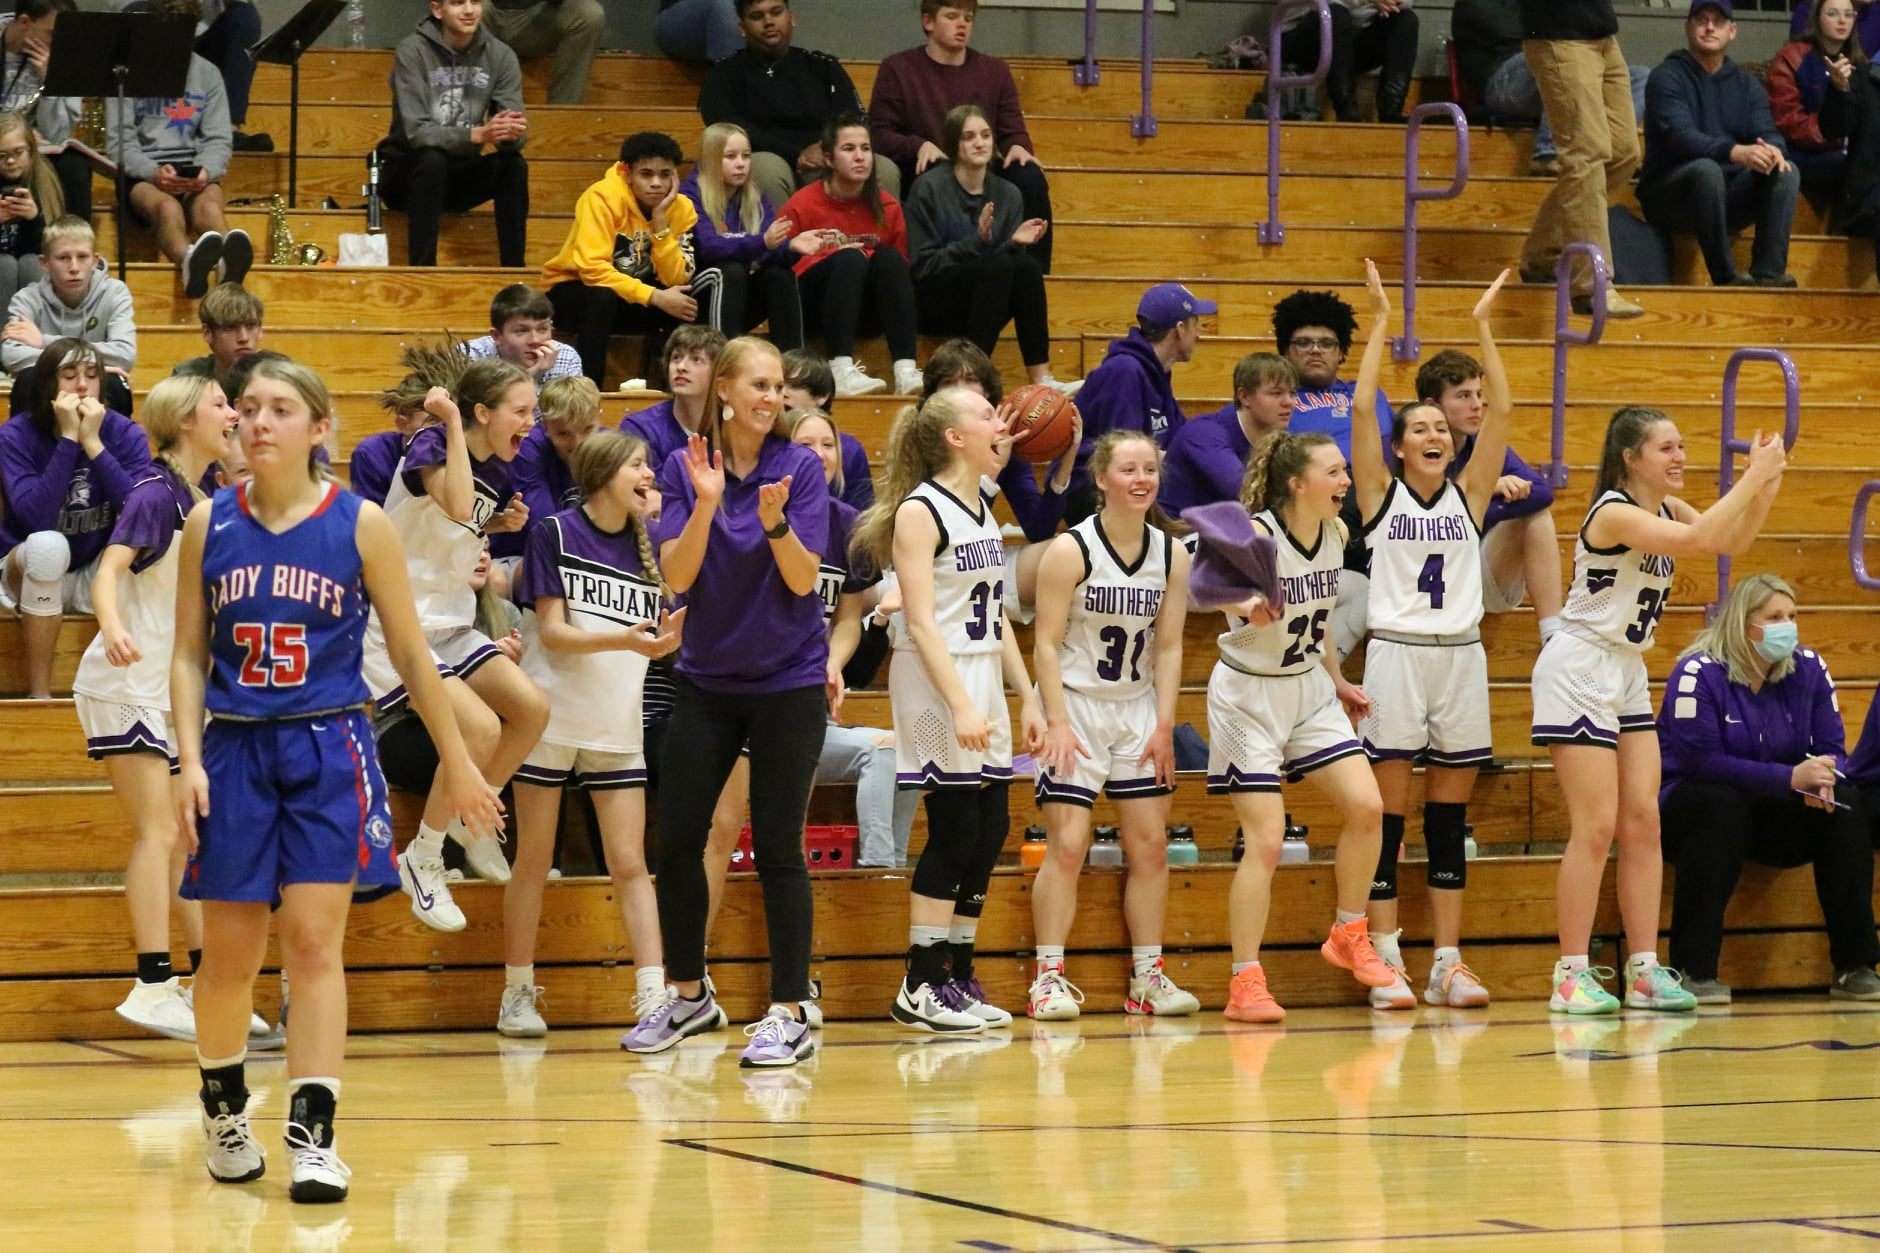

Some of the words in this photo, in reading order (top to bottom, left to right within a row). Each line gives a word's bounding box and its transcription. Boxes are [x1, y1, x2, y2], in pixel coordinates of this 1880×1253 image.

[1388, 514, 1468, 541] SOUTHEAST
[272, 564, 345, 617] BUFFS
[564, 571, 664, 621] TROJAN
[1279, 567, 1343, 605] SOUTHEAS
[1417, 554, 1446, 610] 4
[233, 622, 309, 687] 25
